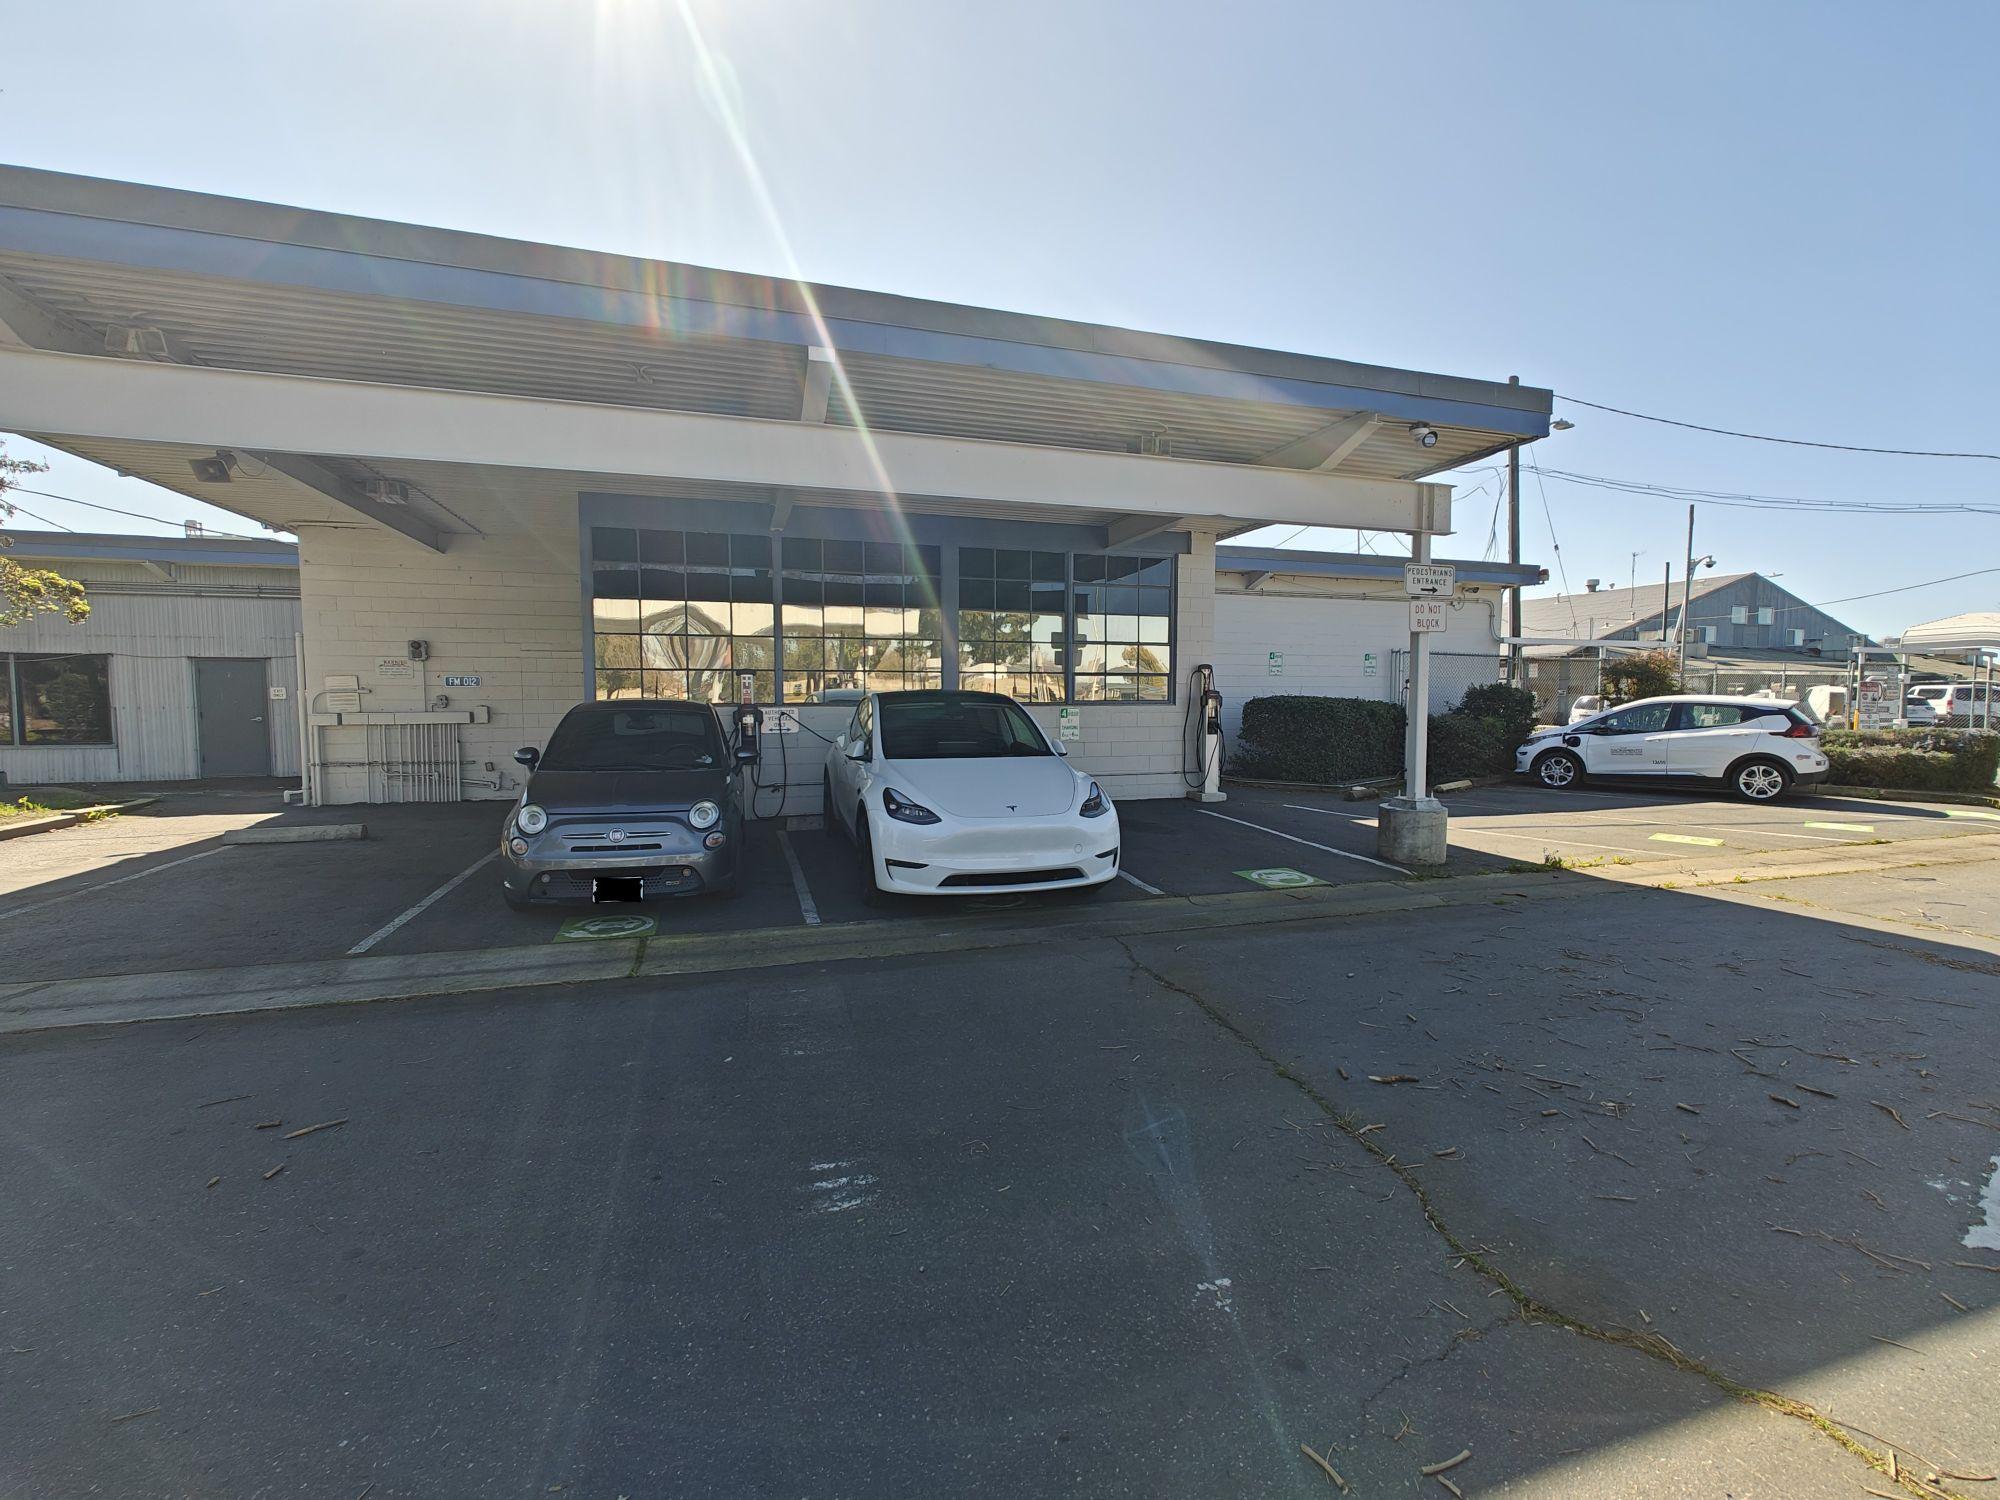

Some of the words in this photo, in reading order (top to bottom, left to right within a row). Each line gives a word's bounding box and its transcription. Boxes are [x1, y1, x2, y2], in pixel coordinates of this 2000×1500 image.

[1407, 567, 1453, 577] PEDESTRIANS
[1412, 578, 1447, 586] ENTRANCE
[1415, 604, 1424, 614] DO
[1428, 604, 1441, 614] NOT
[1417, 619, 1440, 628] BLOCK
[449, 677, 461, 686] FM
[463, 677, 477, 686] 012
